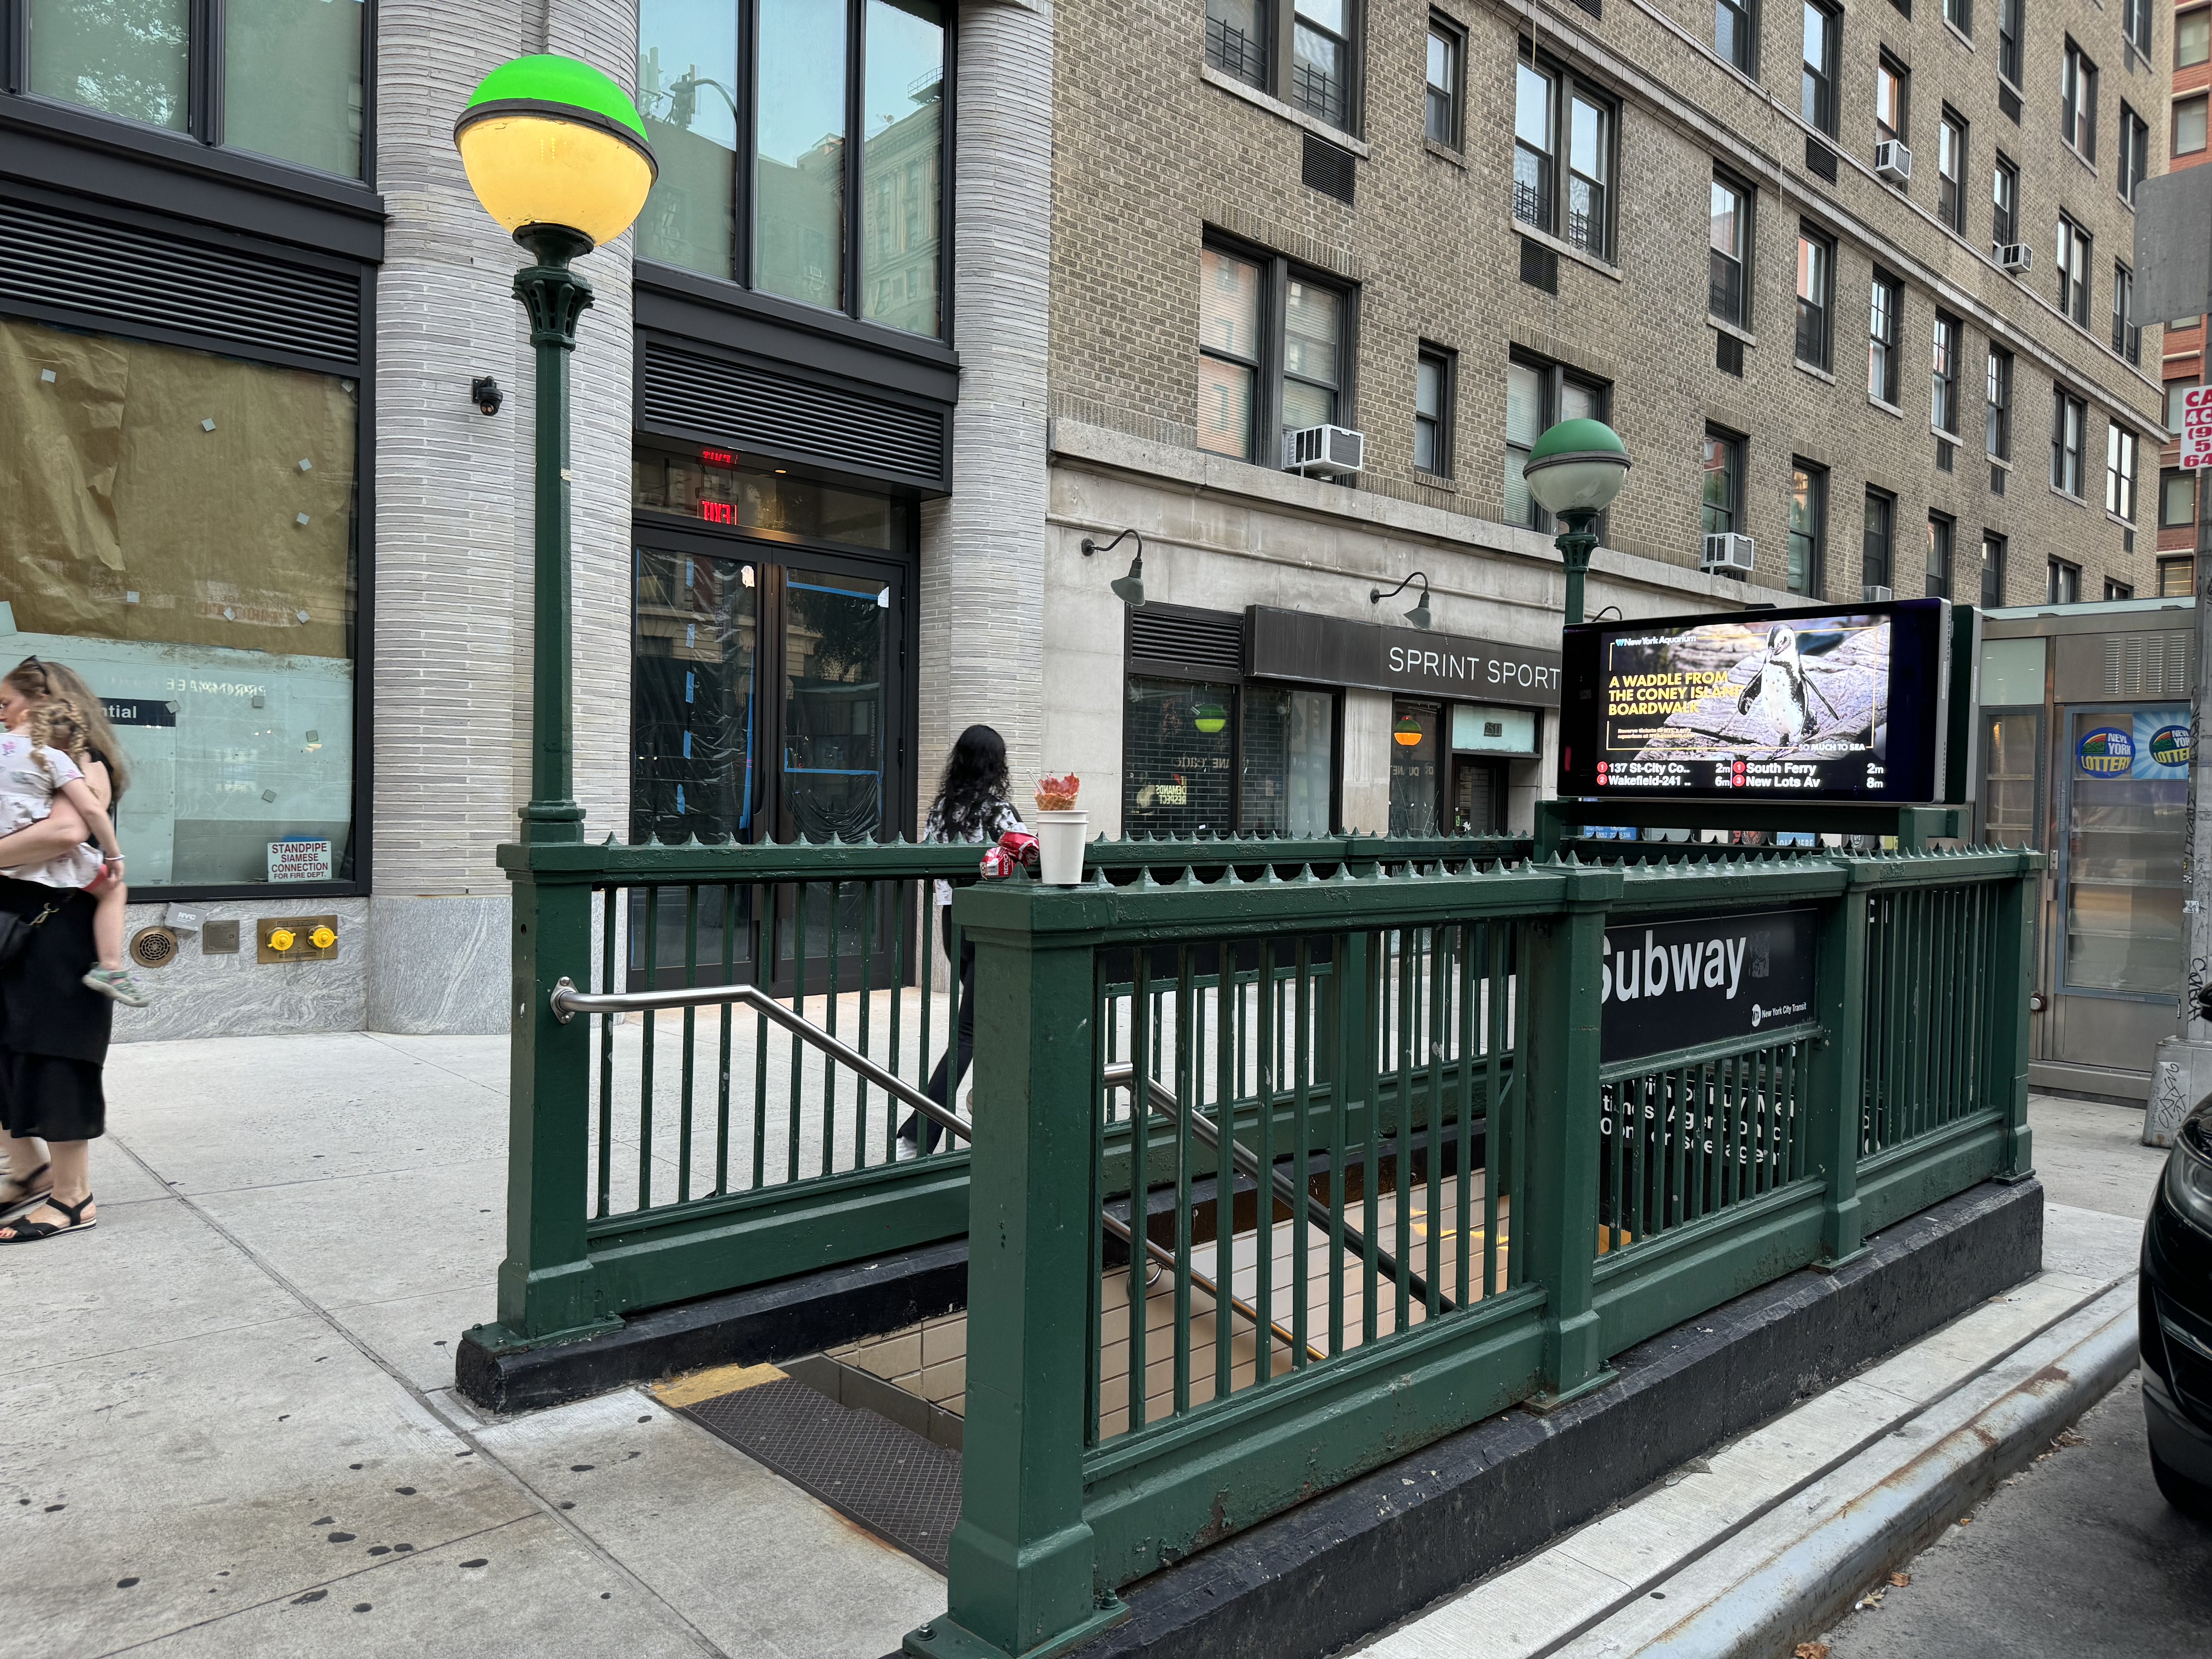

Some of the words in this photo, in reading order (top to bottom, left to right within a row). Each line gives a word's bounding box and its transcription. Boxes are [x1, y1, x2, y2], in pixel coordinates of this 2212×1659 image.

[1624, 637, 1642, 646] New
[1642, 637, 1658, 645] York
[1658, 635, 1696, 646] Aquarium
[1389, 646, 1480, 680] SPRINT
[1487, 659, 1561, 690] SPORT
[1609, 676, 1620, 688] A
[1623, 672, 1681, 687] WADDLE
[1685, 670, 1728, 685] FROM
[1609, 689, 1633, 701] THE
[1636, 687, 1688, 701] CONEY
[1691, 684, 1745, 699] ISLAND
[1608, 701, 1700, 716] BOARDWALK
[2108, 733, 2127, 743] NEW
[2108, 743, 2131, 755] YORK
[2154, 748, 2189, 763] LOTTE
[1609, 763, 1628, 773] 137
[1630, 763, 1666, 775] St-City
[1716, 763, 1730, 773] 2m
[1746, 763, 1781, 774] South
[1784, 763, 1817, 776] Ferry
[1867, 763, 1884, 774] 2m
[2081, 756, 2131, 772] LOTTERY
[1608, 776, 1681, 786] Wakefield-241
[1715, 776, 1730, 786] 6m
[1746, 776, 1772, 787] New
[1774, 776, 1801, 787] Lots
[1803, 776, 1820, 787] Av
[1867, 777, 1883, 788] 8m
[272, 843, 327, 854] STANDPIPE
[281, 853, 319, 862] SIAMESE
[271, 862, 328, 872] CONNECTION
[178, 912, 196, 920] NYC
[1762, 1010, 1772, 1018] New
[1772, 1007, 1782, 1016] York
[1783, 1005, 1791, 1015] City
[1792, 1002, 1807, 1012] Transit
